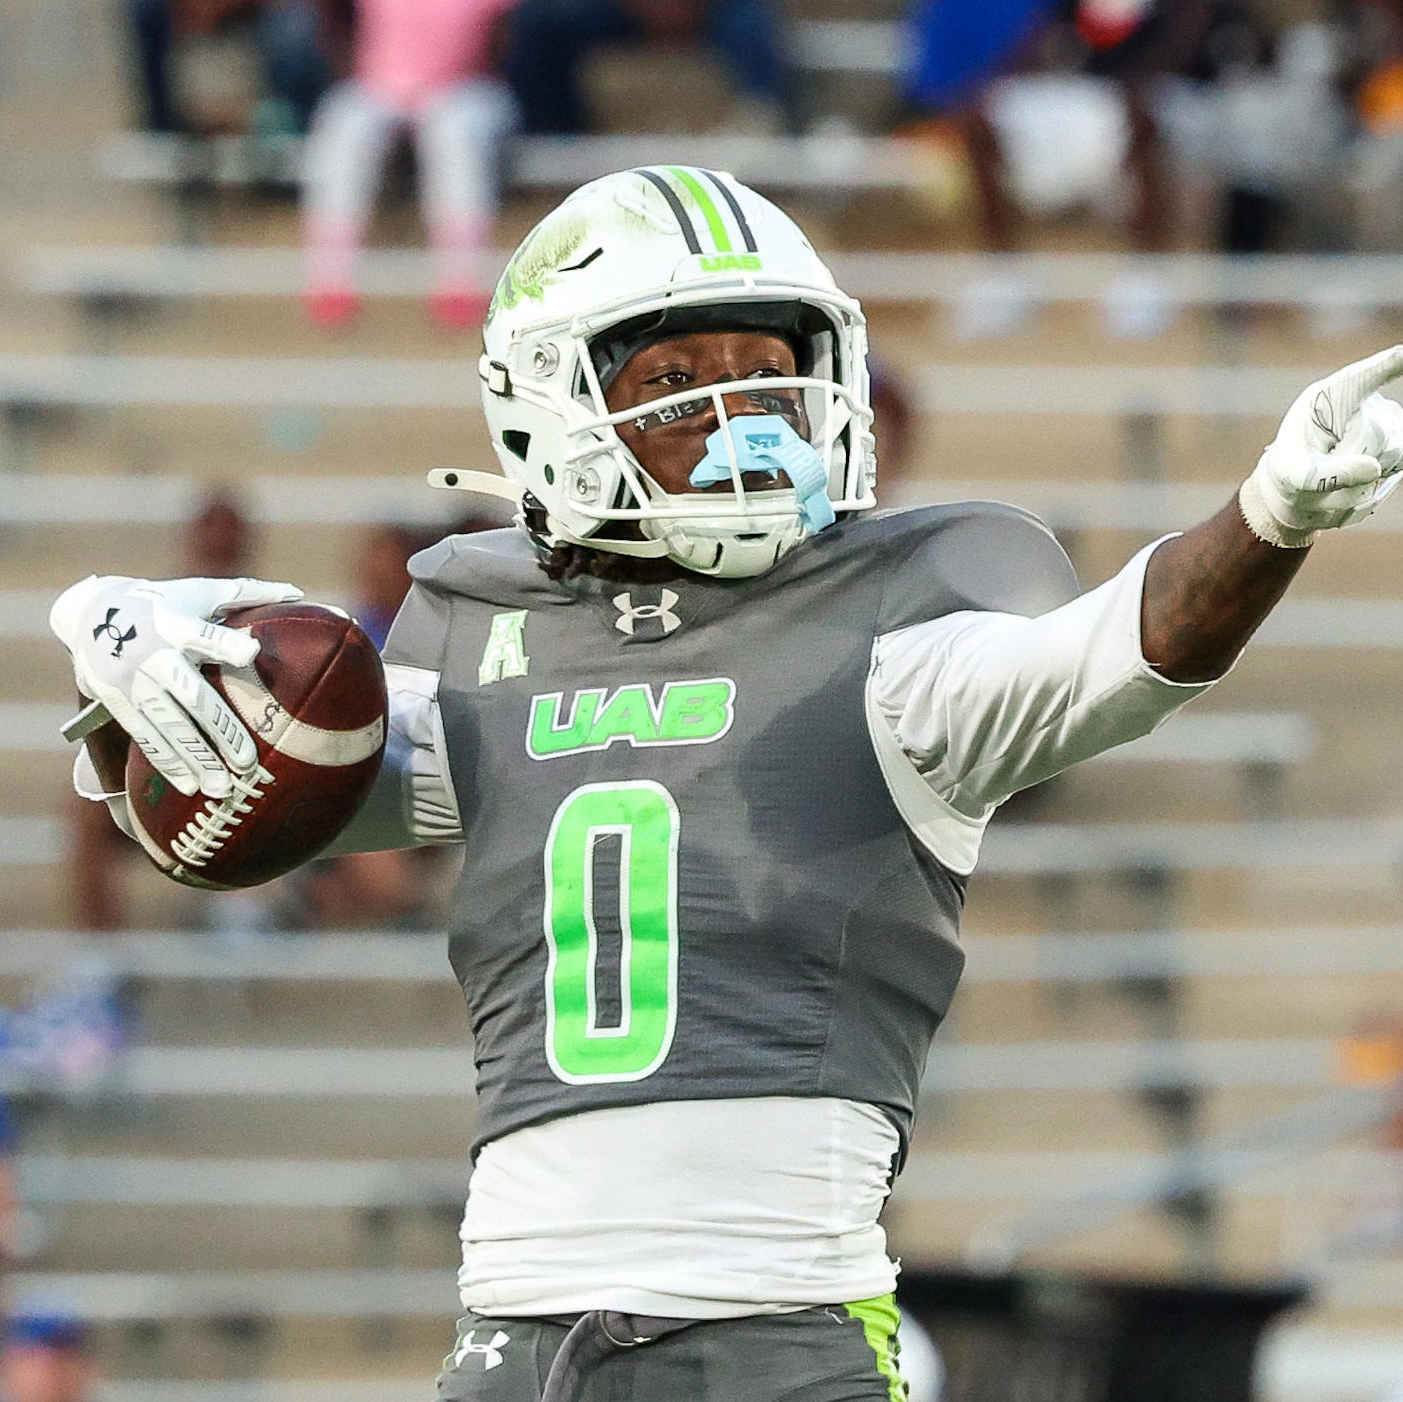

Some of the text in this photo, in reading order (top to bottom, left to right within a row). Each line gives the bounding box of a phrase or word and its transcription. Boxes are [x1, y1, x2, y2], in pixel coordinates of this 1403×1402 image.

[699, 254, 762, 272] UAB
[478, 609, 529, 687] A
[526, 677, 736, 760] UAB
[544, 780, 681, 1086] 0
